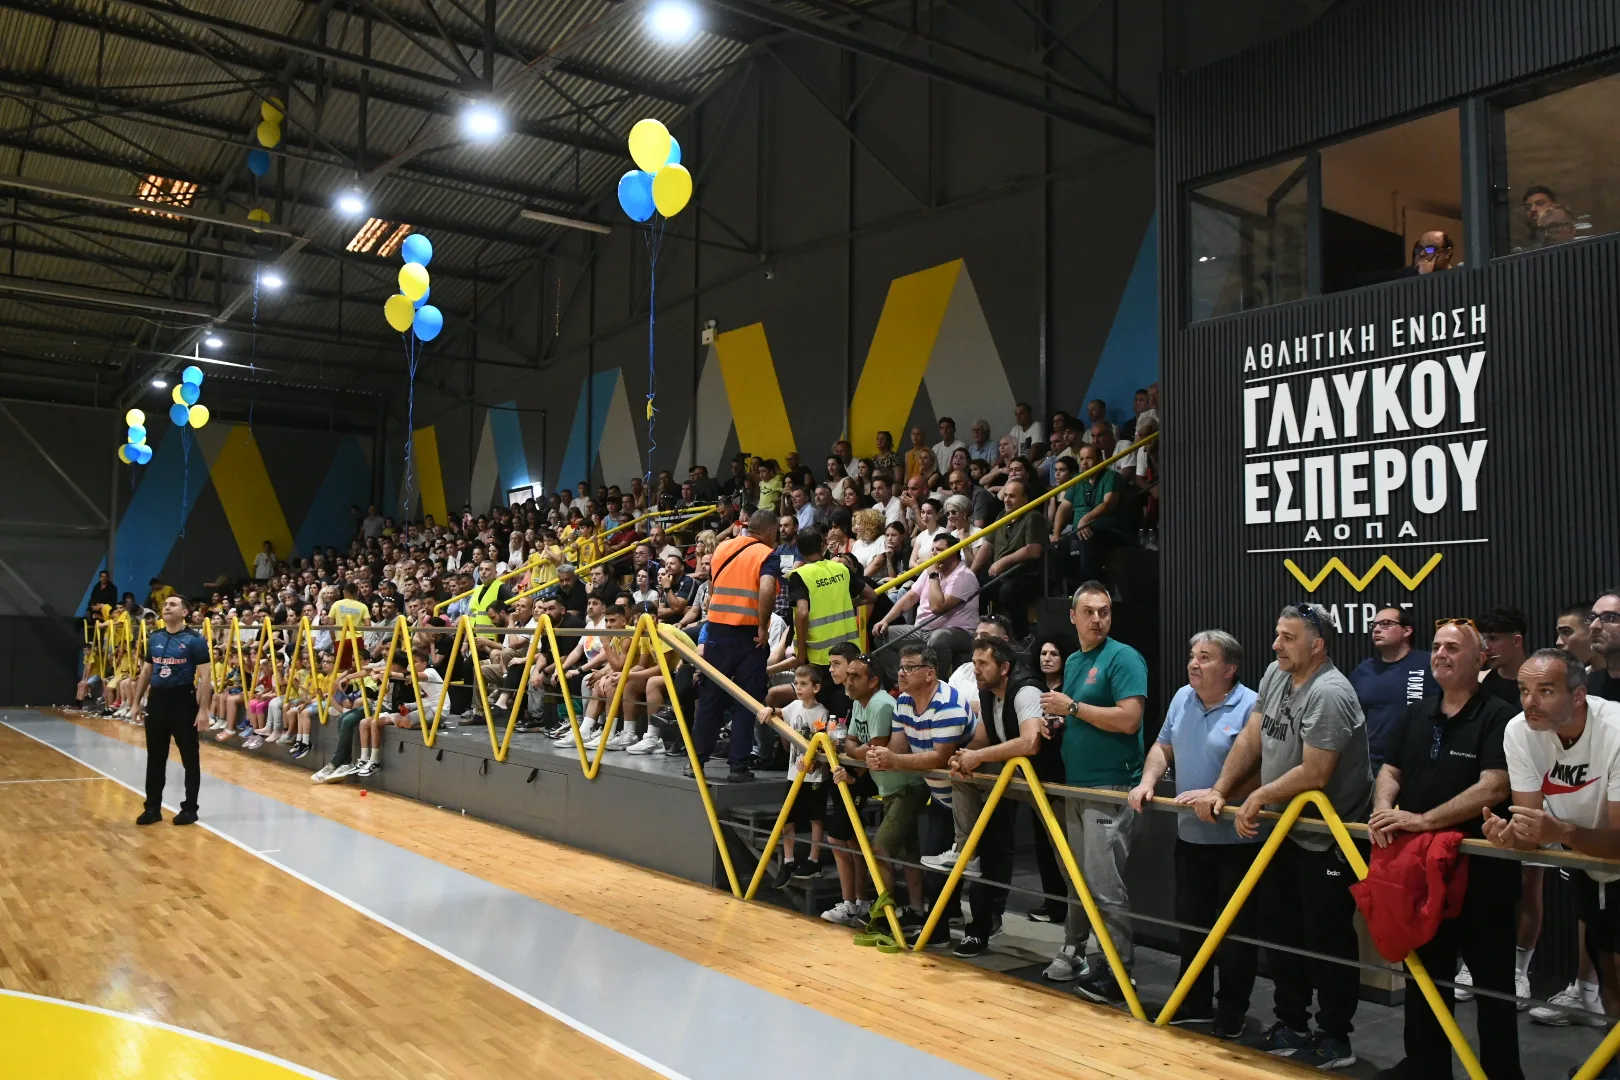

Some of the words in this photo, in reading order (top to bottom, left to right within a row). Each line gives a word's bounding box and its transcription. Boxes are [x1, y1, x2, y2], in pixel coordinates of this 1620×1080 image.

[1244, 324, 1375, 373] ΑΘΛΗΤΙΚΗ
[1392, 304, 1486, 347] ΕΝΩΣΗ
[1243, 350, 1486, 449] ΓΛΑΥΚΟΥ
[1245, 439, 1488, 525] ΕΣΠΕΡΟΥ
[1304, 520, 1417, 542] ΑΟΠΑ
[1312, 603, 1414, 634] ΑΤΡ
[1550, 759, 1589, 786] NIKE
